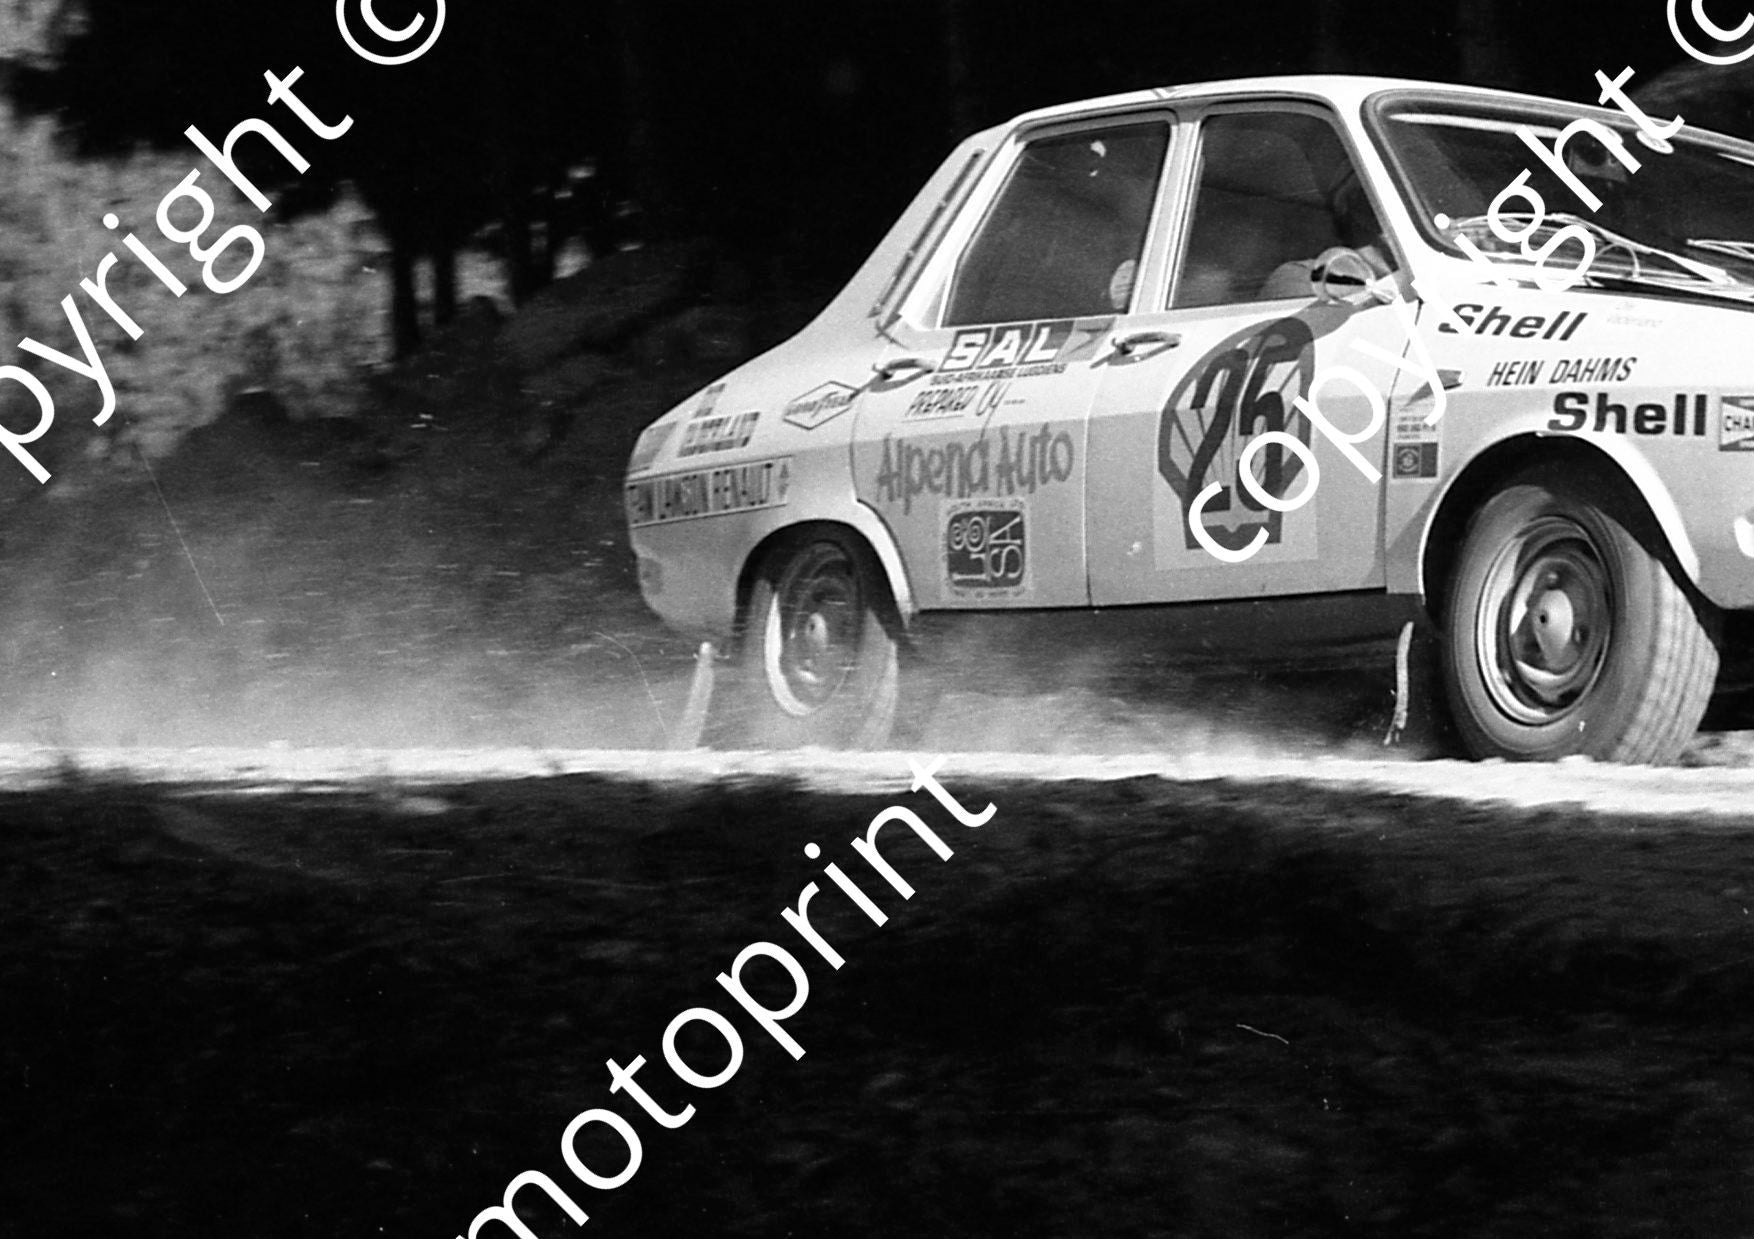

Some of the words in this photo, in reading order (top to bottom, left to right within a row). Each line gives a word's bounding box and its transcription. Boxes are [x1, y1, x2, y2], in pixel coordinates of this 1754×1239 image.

[1438, 303, 1588, 341] Shell
[941, 327, 1059, 371] SAL
[1487, 361, 1544, 386] HEIN
[1549, 357, 1637, 384] DAHMS
[1186, 317, 1314, 512] 25
[1547, 392, 1707, 435] Shell
[996, 422, 1073, 496] Auto
